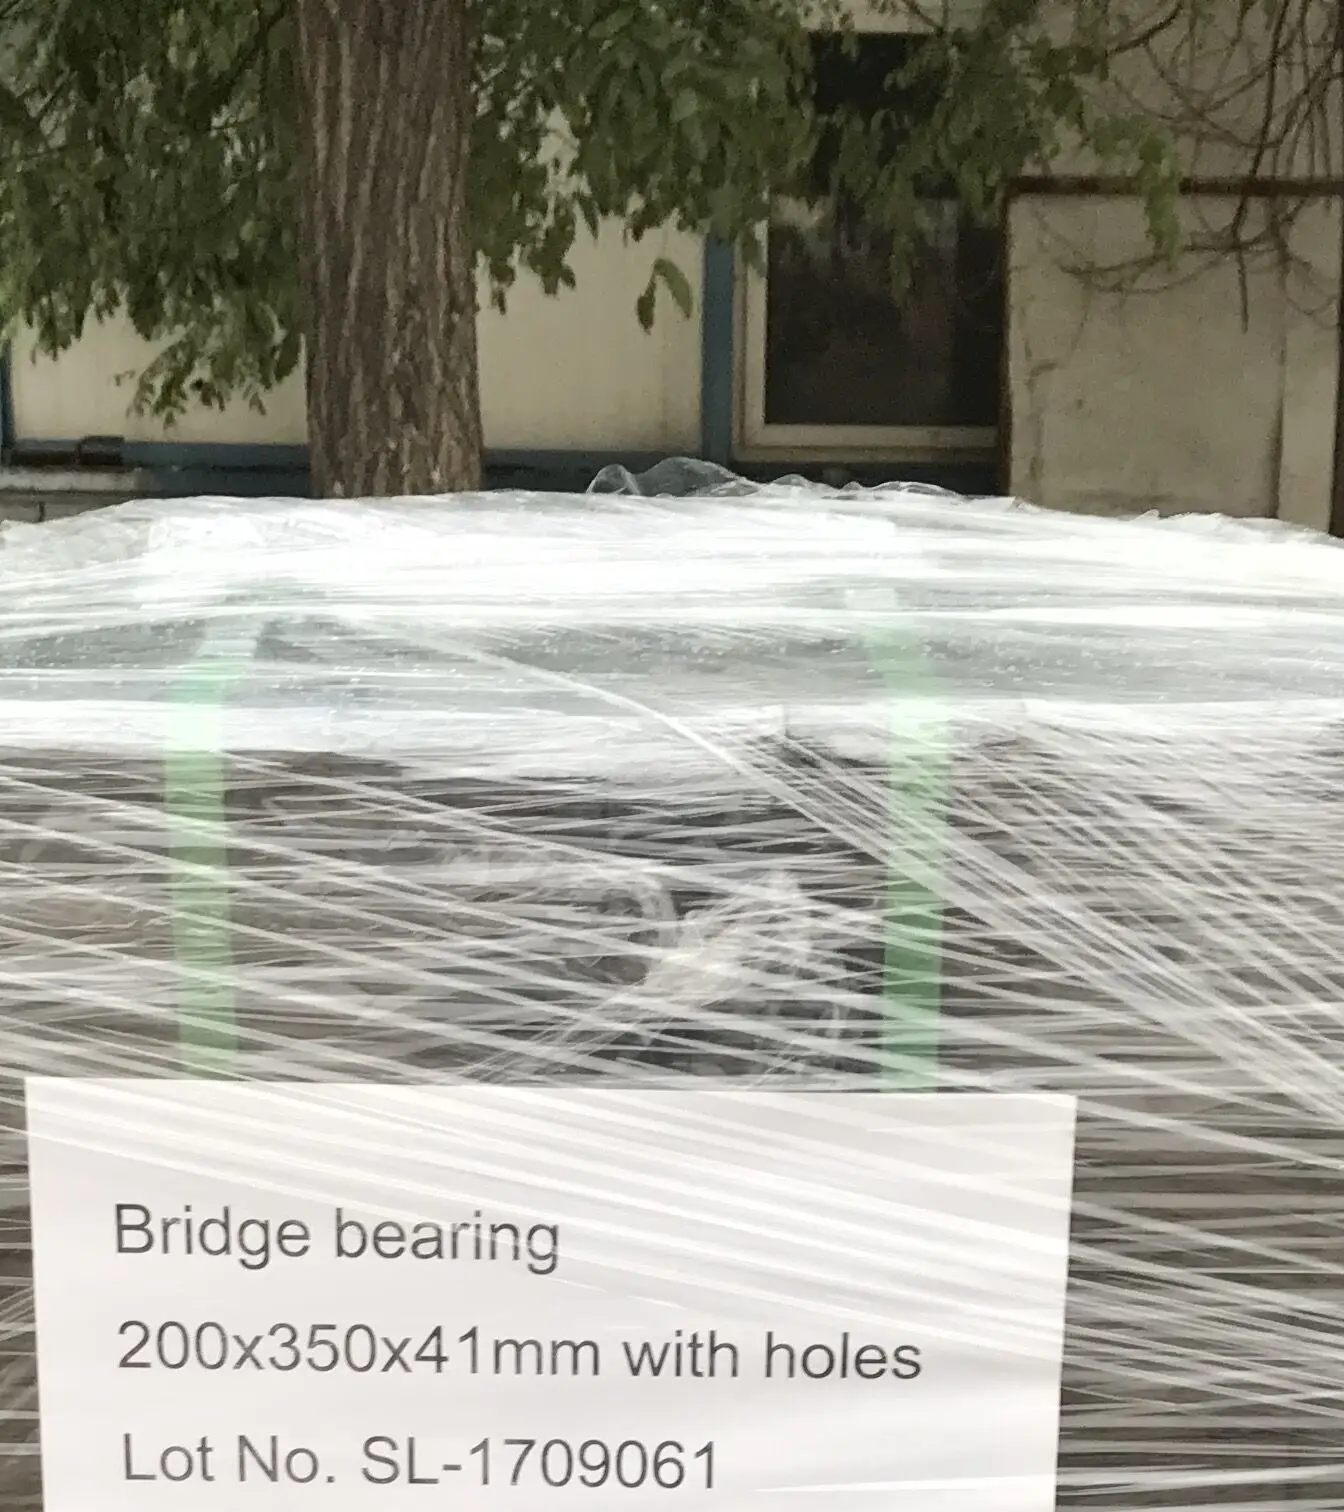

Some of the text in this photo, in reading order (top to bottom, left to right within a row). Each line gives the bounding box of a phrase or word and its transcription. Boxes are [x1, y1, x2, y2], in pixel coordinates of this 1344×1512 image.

[115, 1203, 558, 1275] Bridge bearing
[118, 1320, 923, 1379] 200x350x41mm with holes
[124, 1433, 713, 1489] Lot No. SL-1709061
